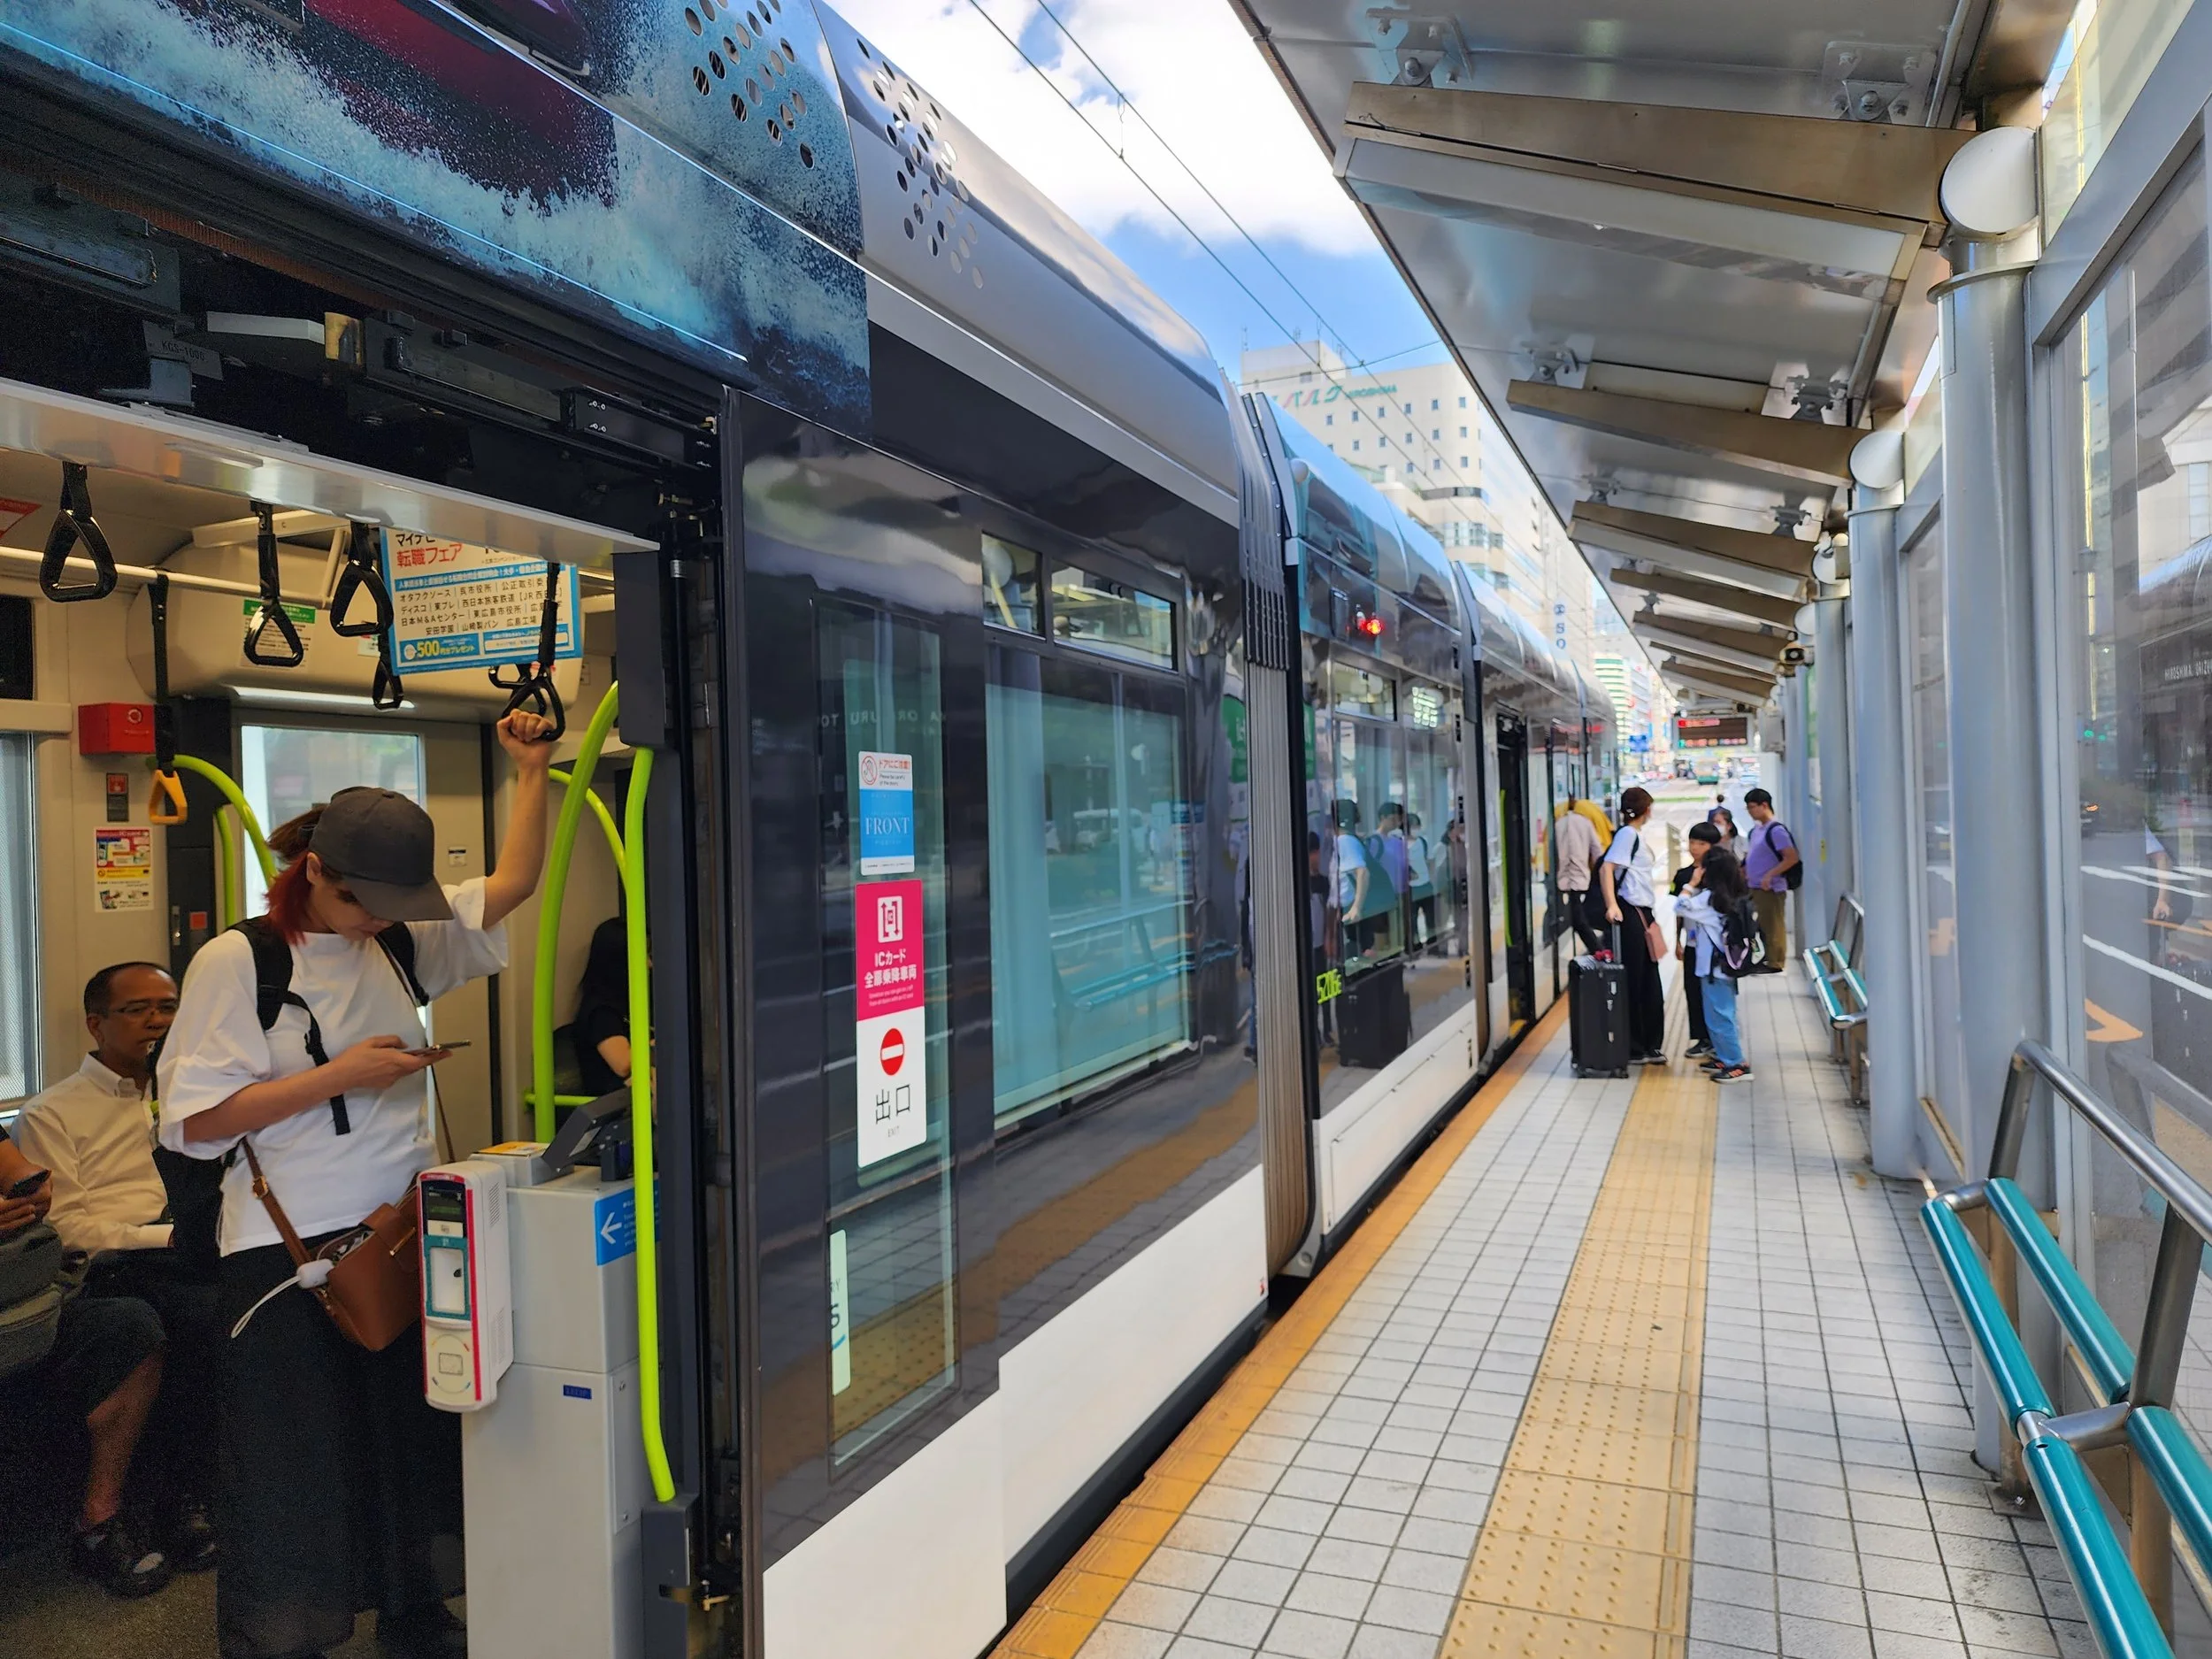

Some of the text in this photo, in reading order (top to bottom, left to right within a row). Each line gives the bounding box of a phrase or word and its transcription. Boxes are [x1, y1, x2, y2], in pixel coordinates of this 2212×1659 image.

[396, 542, 463, 567] 転職フェア
[399, 589, 451, 603] オタフクソース
[401, 611, 465, 626] 日本M&Aセンター
[865, 816, 910, 835] FRONT
[874, 948, 907, 968] ICカード
[864, 964, 918, 989] 全扉乗降車両
[875, 1083, 910, 1125] 出口
